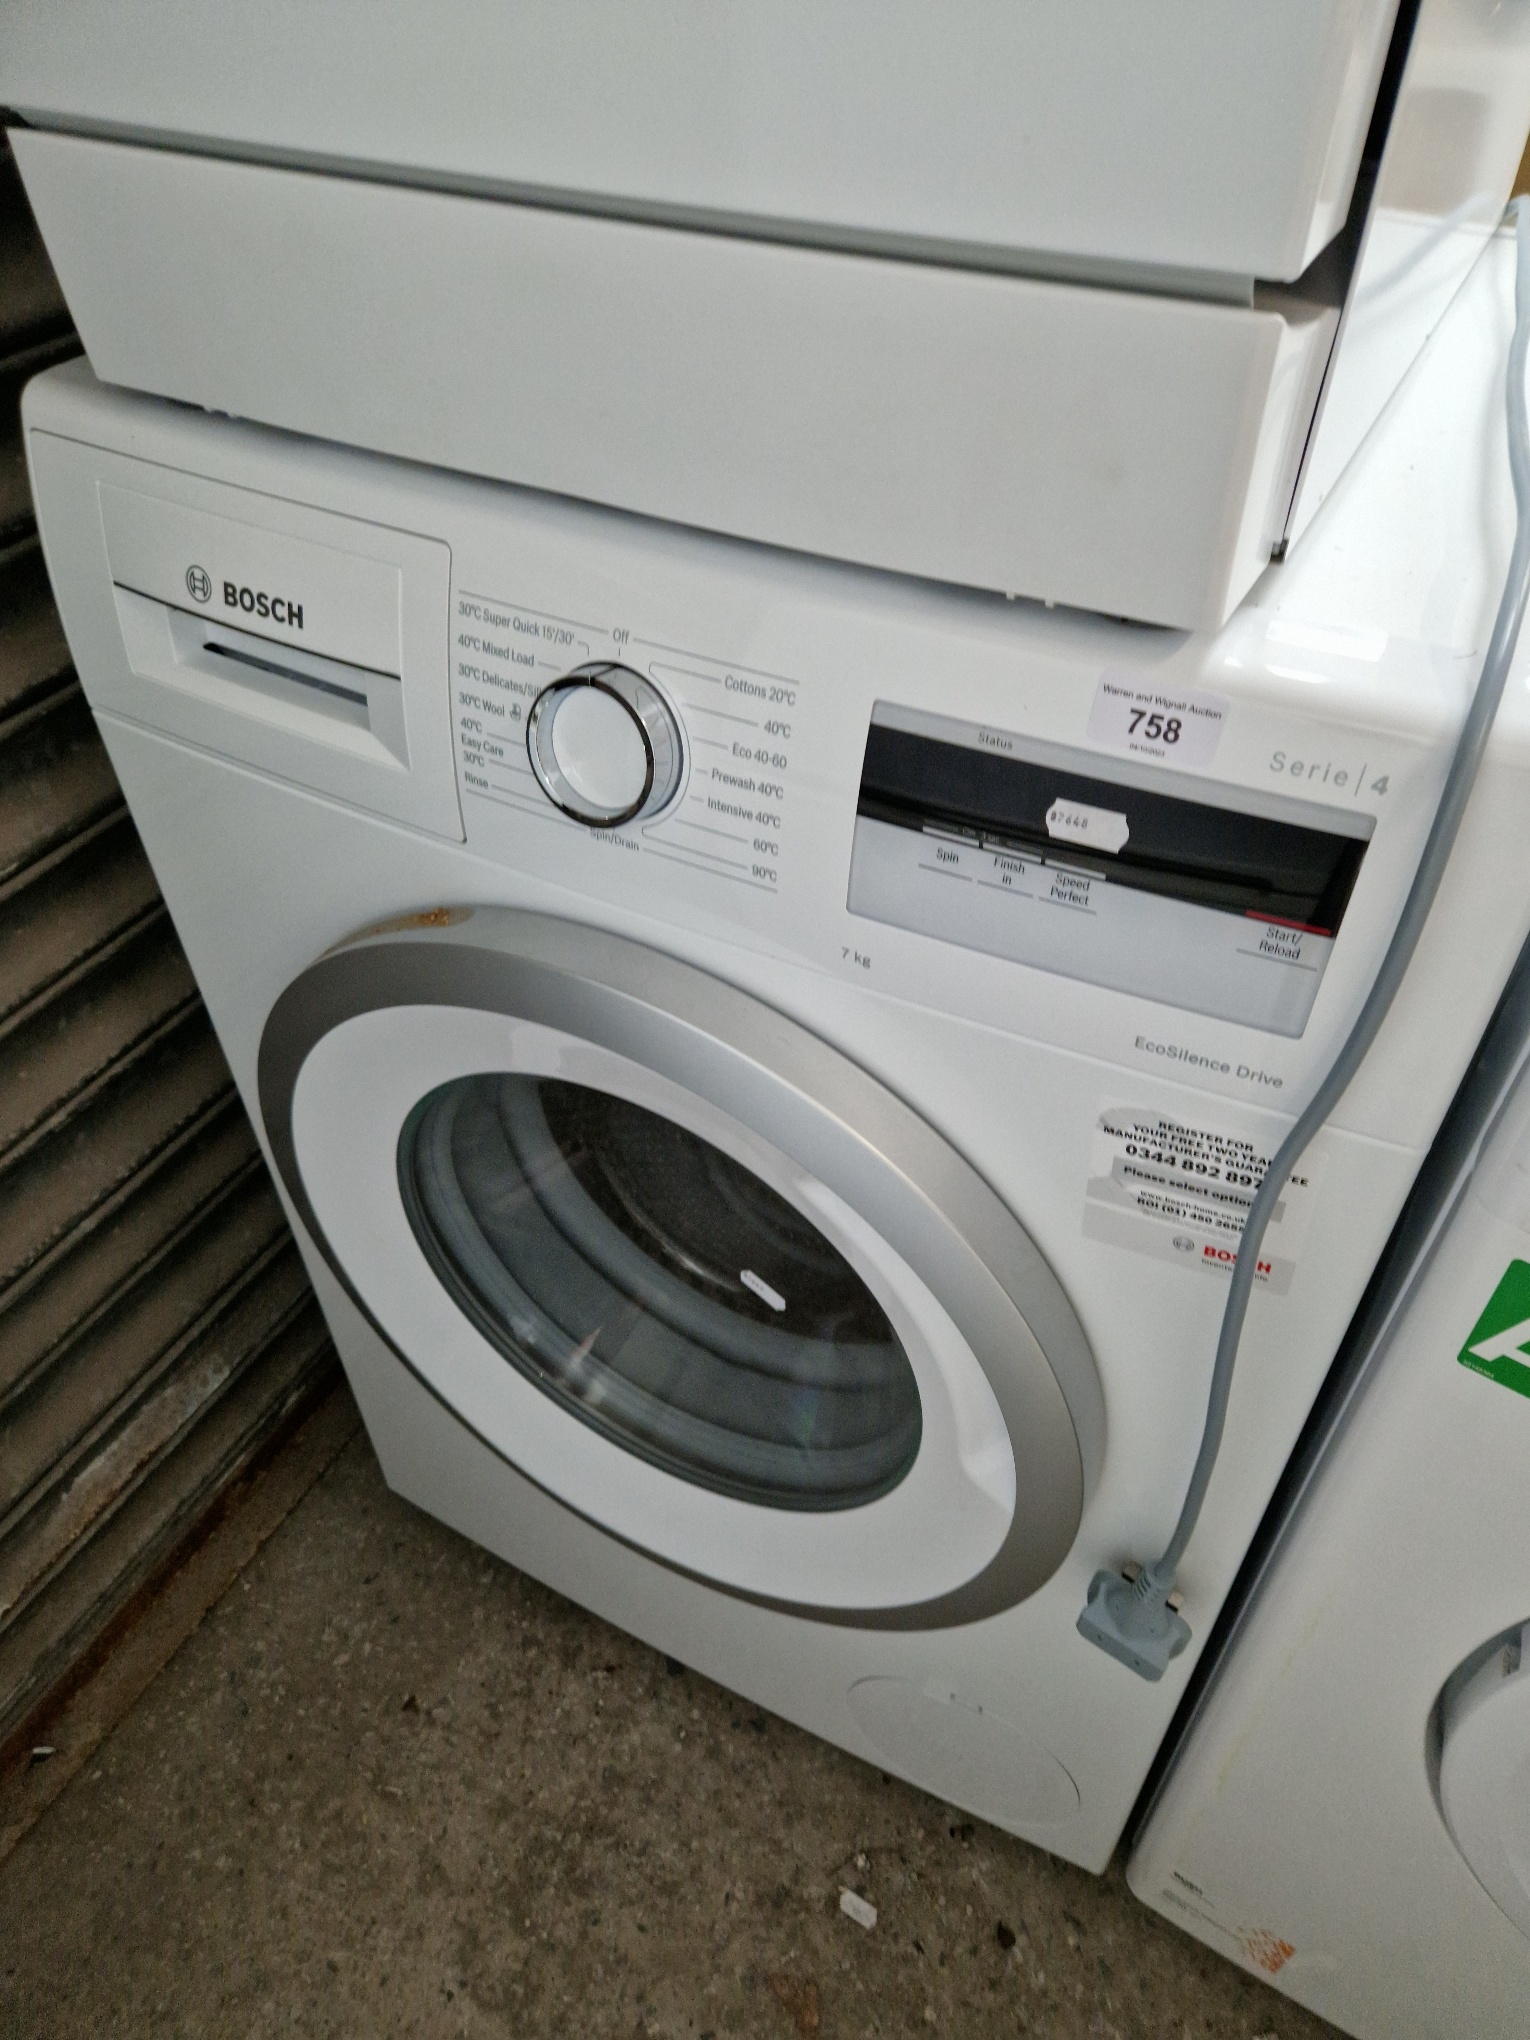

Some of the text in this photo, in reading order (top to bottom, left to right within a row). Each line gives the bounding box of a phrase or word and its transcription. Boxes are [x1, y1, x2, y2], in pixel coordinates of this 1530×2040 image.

[223, 581, 303, 629] BOSCH
[458, 601, 481, 619] 30°C
[483, 608, 510, 628] Super
[513, 617, 540, 636] Quick
[613, 627, 630, 644] Off
[458, 633, 535, 667] 40°C Mixed Load
[458, 663, 481, 681] 30°C
[724, 674, 796, 707] Cottons 20°C
[1103, 683, 1222, 720] Warren and Wignall Auction
[459, 691, 505, 717] 30°C Wool
[764, 719, 792, 739] 40°C
[1128, 707, 1182, 744] 758
[461, 733, 504, 758] Easy Care
[978, 731, 1013, 750] Status
[732, 742, 787, 769] Eco 40-60
[464, 770, 488, 788] Rinse
[711, 767, 784, 799] Prewash 40°C
[707, 798, 781, 829] Intensive 40°C
[753, 838, 779, 857] 60°C
[936, 847, 959, 865] Spin
[751, 864, 778, 883] 90°C
[994, 856, 1025, 875] Finish
[1002, 874, 1012, 886] in
[1055, 872, 1091, 892] Speed
[1050, 886, 1089, 907] Perfect
[1266, 925, 1303, 947] Start/
[841, 946, 871, 969] 7 kg
[1259, 940, 1301, 961] Reload
[1134, 1035, 1284, 1090] EcoSilence Drive
[1132, 1123, 1168, 1141] YOUR
[1171, 1133, 1204, 1149] FREE
[1208, 1143, 1239, 1159] TWO
[1158, 1119, 1254, 1153] REGISTER FOR
[1103, 1124, 1309, 1188] MANUFACTURER'S GUAREE
[1125, 1143, 1177, 1168] 0344
[1181, 1157, 1221, 1181] 892
[1123, 1164, 1167, 1184] Please
[1169, 1177, 1209, 1198] select
[1136, 1196, 1159, 1210] ROI
[1161, 1203, 1187, 1219] (01)
[1140, 1189, 1246, 1224] www.bosch-home.co.uk
[1203, 1244, 1272, 1275] BOH
